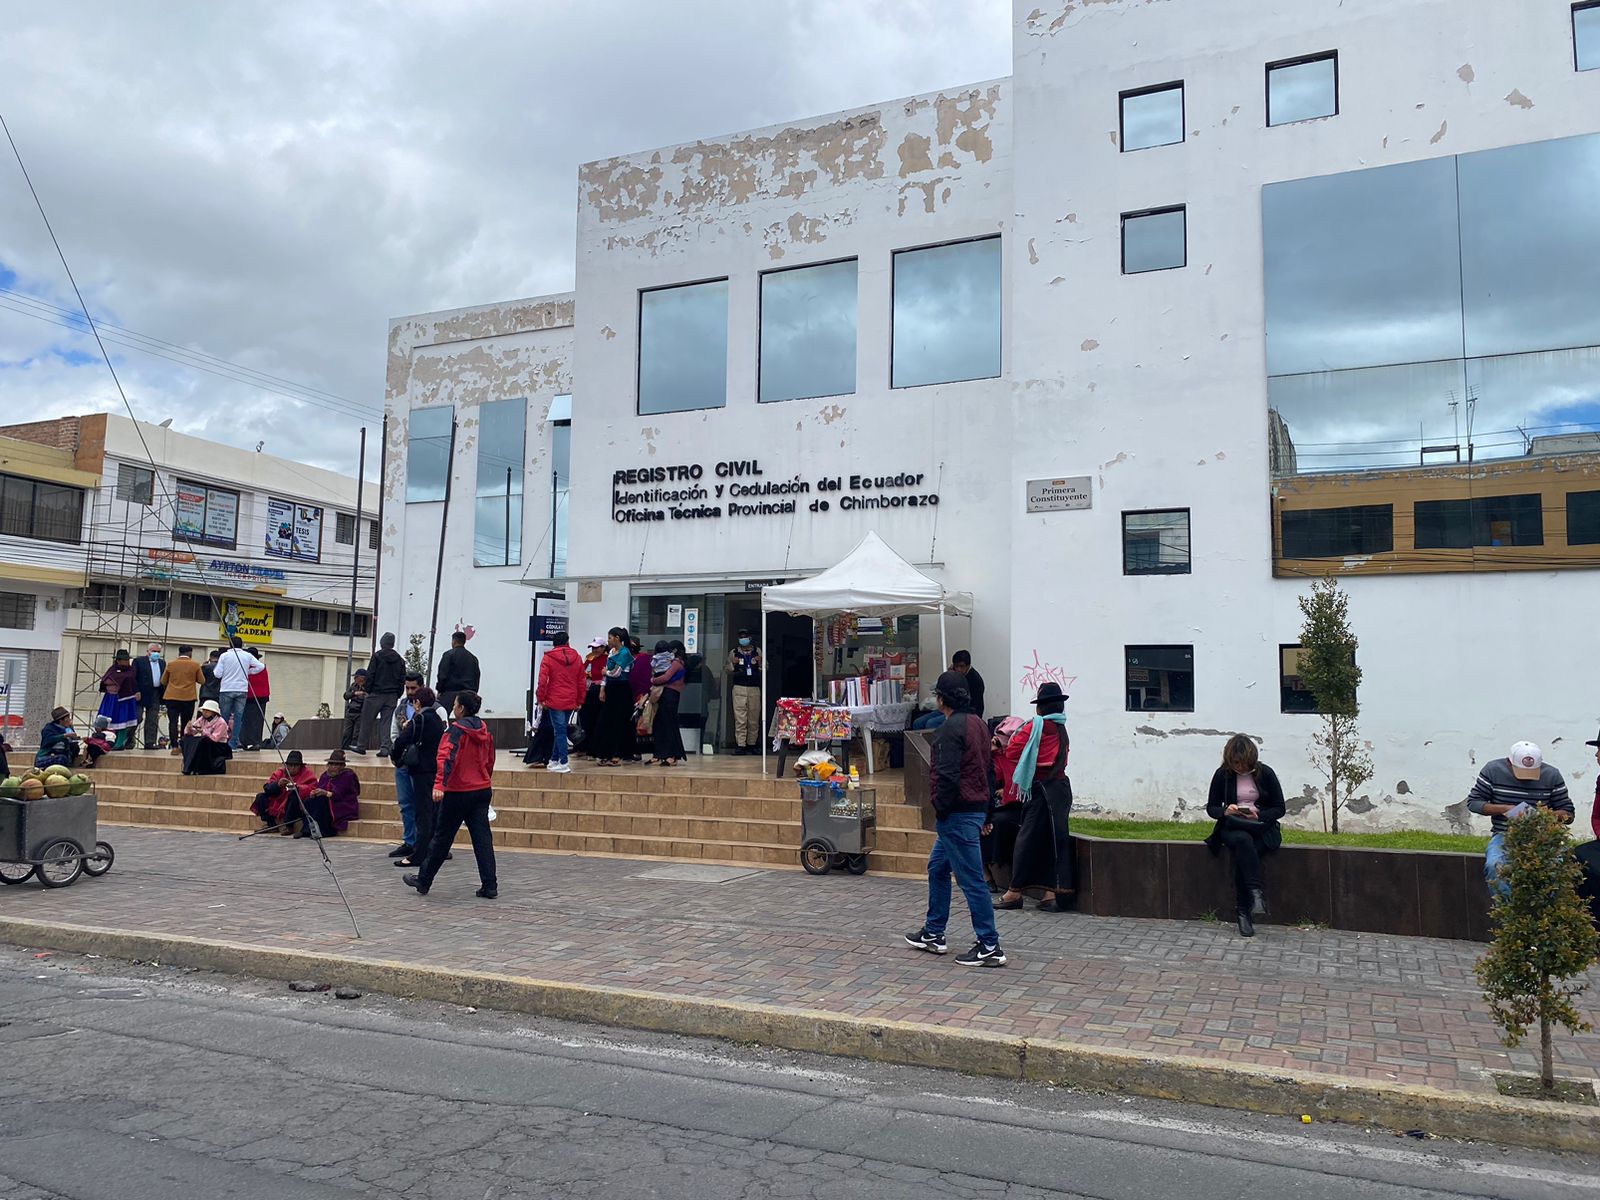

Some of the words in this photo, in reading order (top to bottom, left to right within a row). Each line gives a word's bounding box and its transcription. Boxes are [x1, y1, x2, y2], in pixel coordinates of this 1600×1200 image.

[615, 464, 703, 485] REGISTRO
[715, 460, 763, 477] CIVIL
[615, 483, 708, 505] Identificación
[715, 484, 725, 498] y
[729, 474, 810, 497] Cedulación
[817, 477, 842, 491] del
[849, 473, 924, 490] Ecuador
[1030, 493, 1088, 503] Constituyente
[615, 508, 665, 523] Oficina
[668, 503, 722, 519] Técnica
[728, 499, 796, 516] Provincial
[809, 499, 830, 513] de
[840, 493, 940, 511] Chimborazo
[236, 611, 272, 627] Smart
